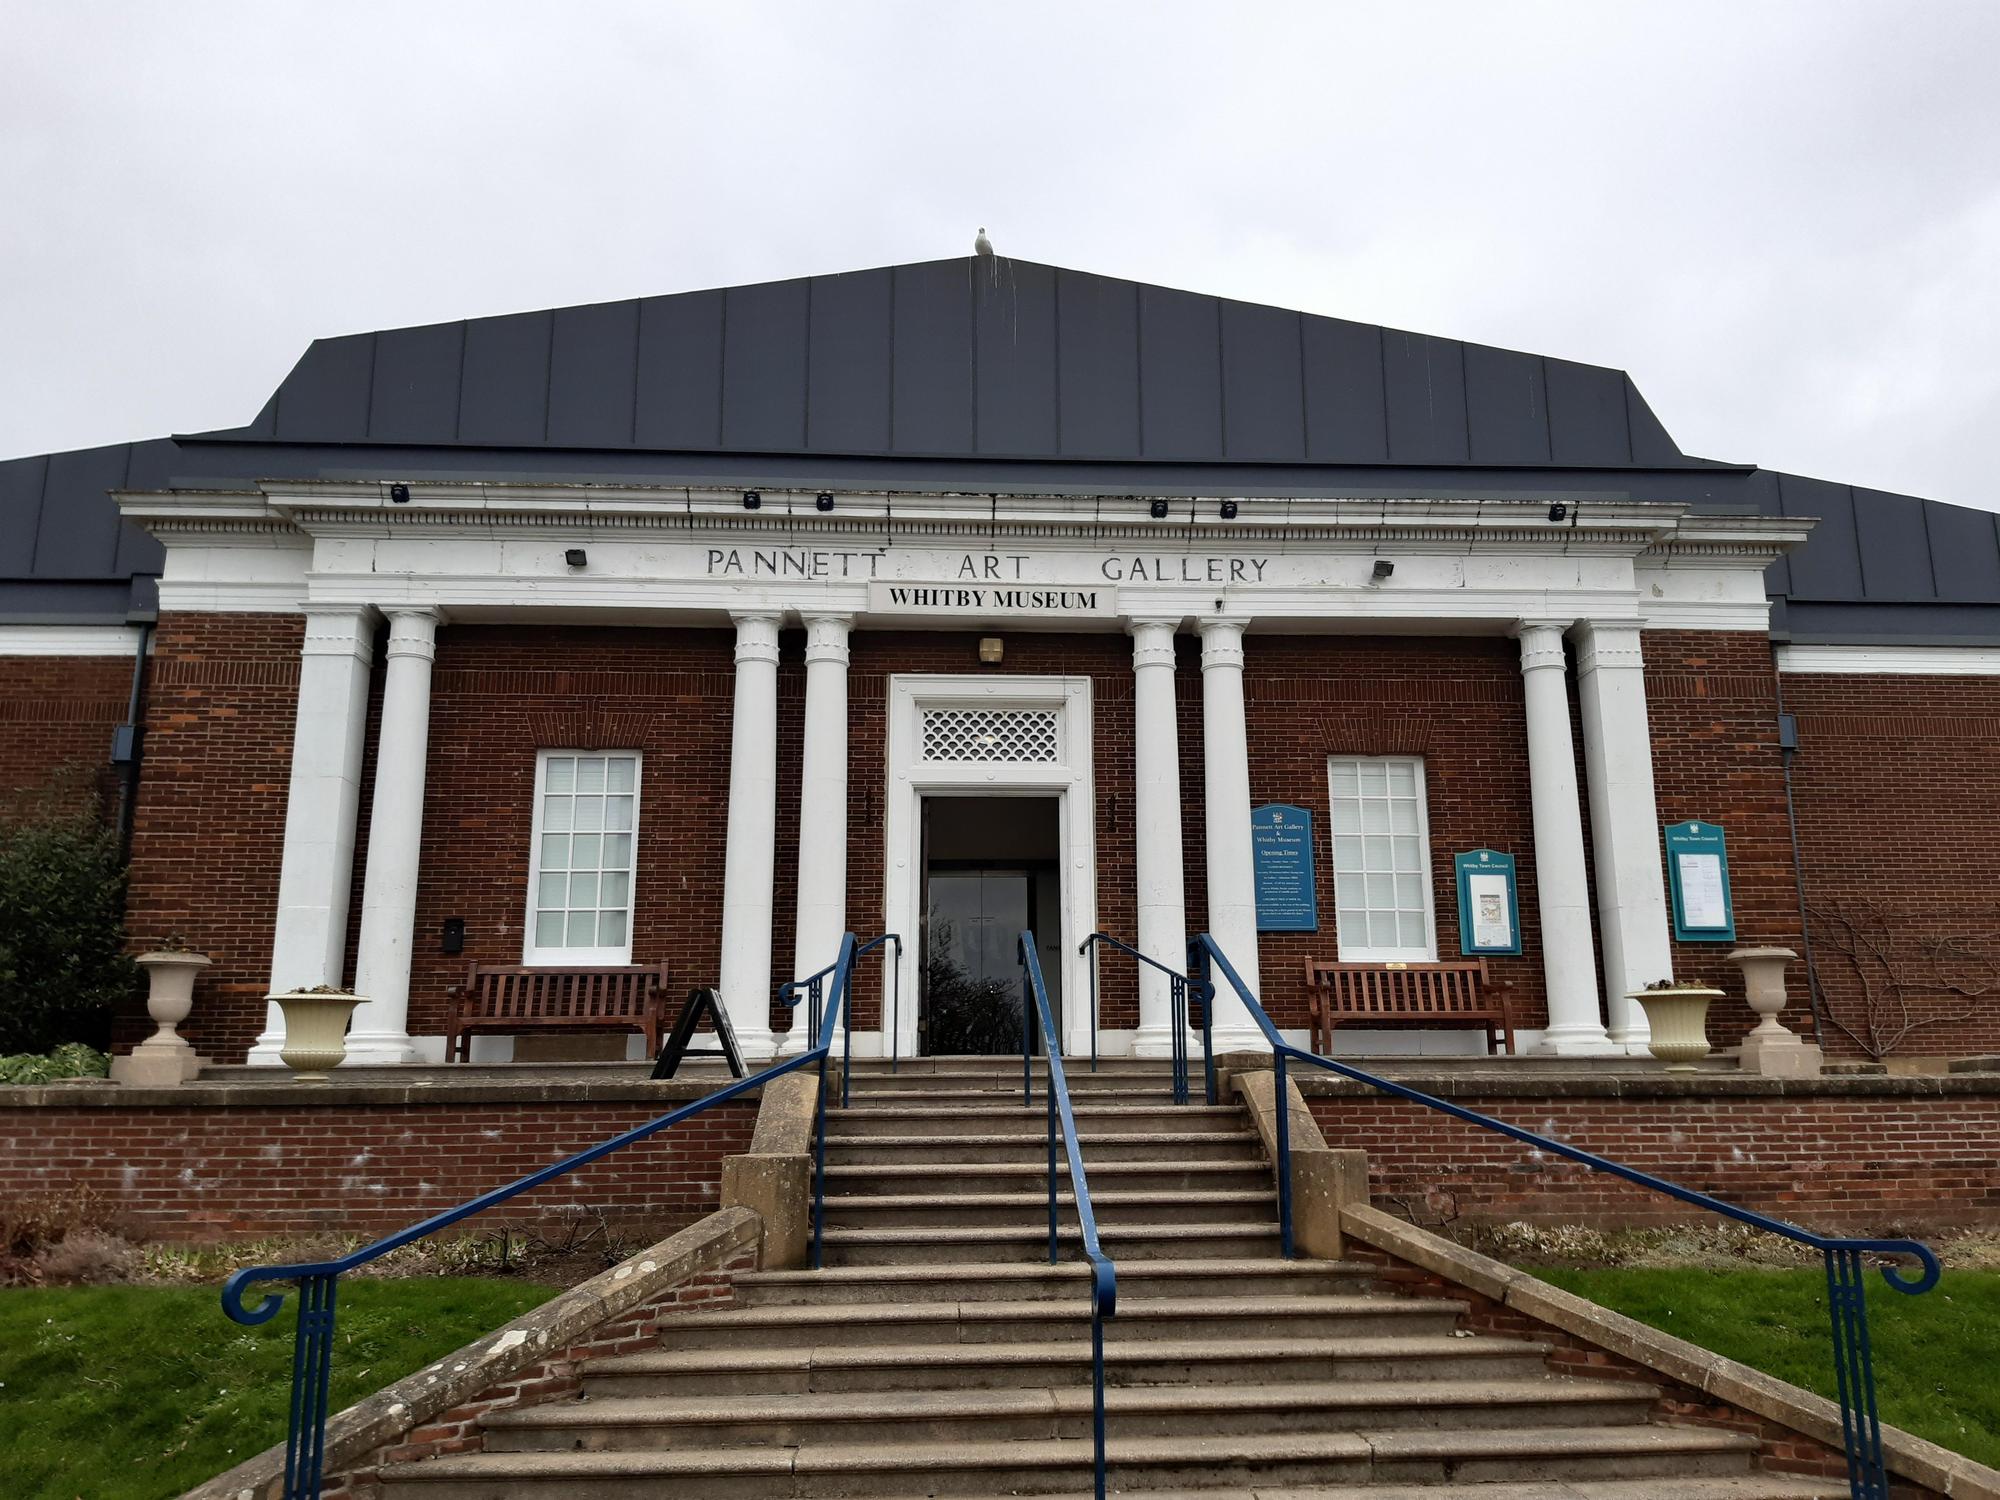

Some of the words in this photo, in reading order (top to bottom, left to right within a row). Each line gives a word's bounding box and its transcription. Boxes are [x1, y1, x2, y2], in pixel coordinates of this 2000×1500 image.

[707, 549, 886, 577] PANNETT
[957, 555, 1030, 579] ART
[1101, 557, 1269, 582] GALLERY
[889, 588, 988, 607] WHITBY
[993, 591, 1098, 610] MUSEUM
